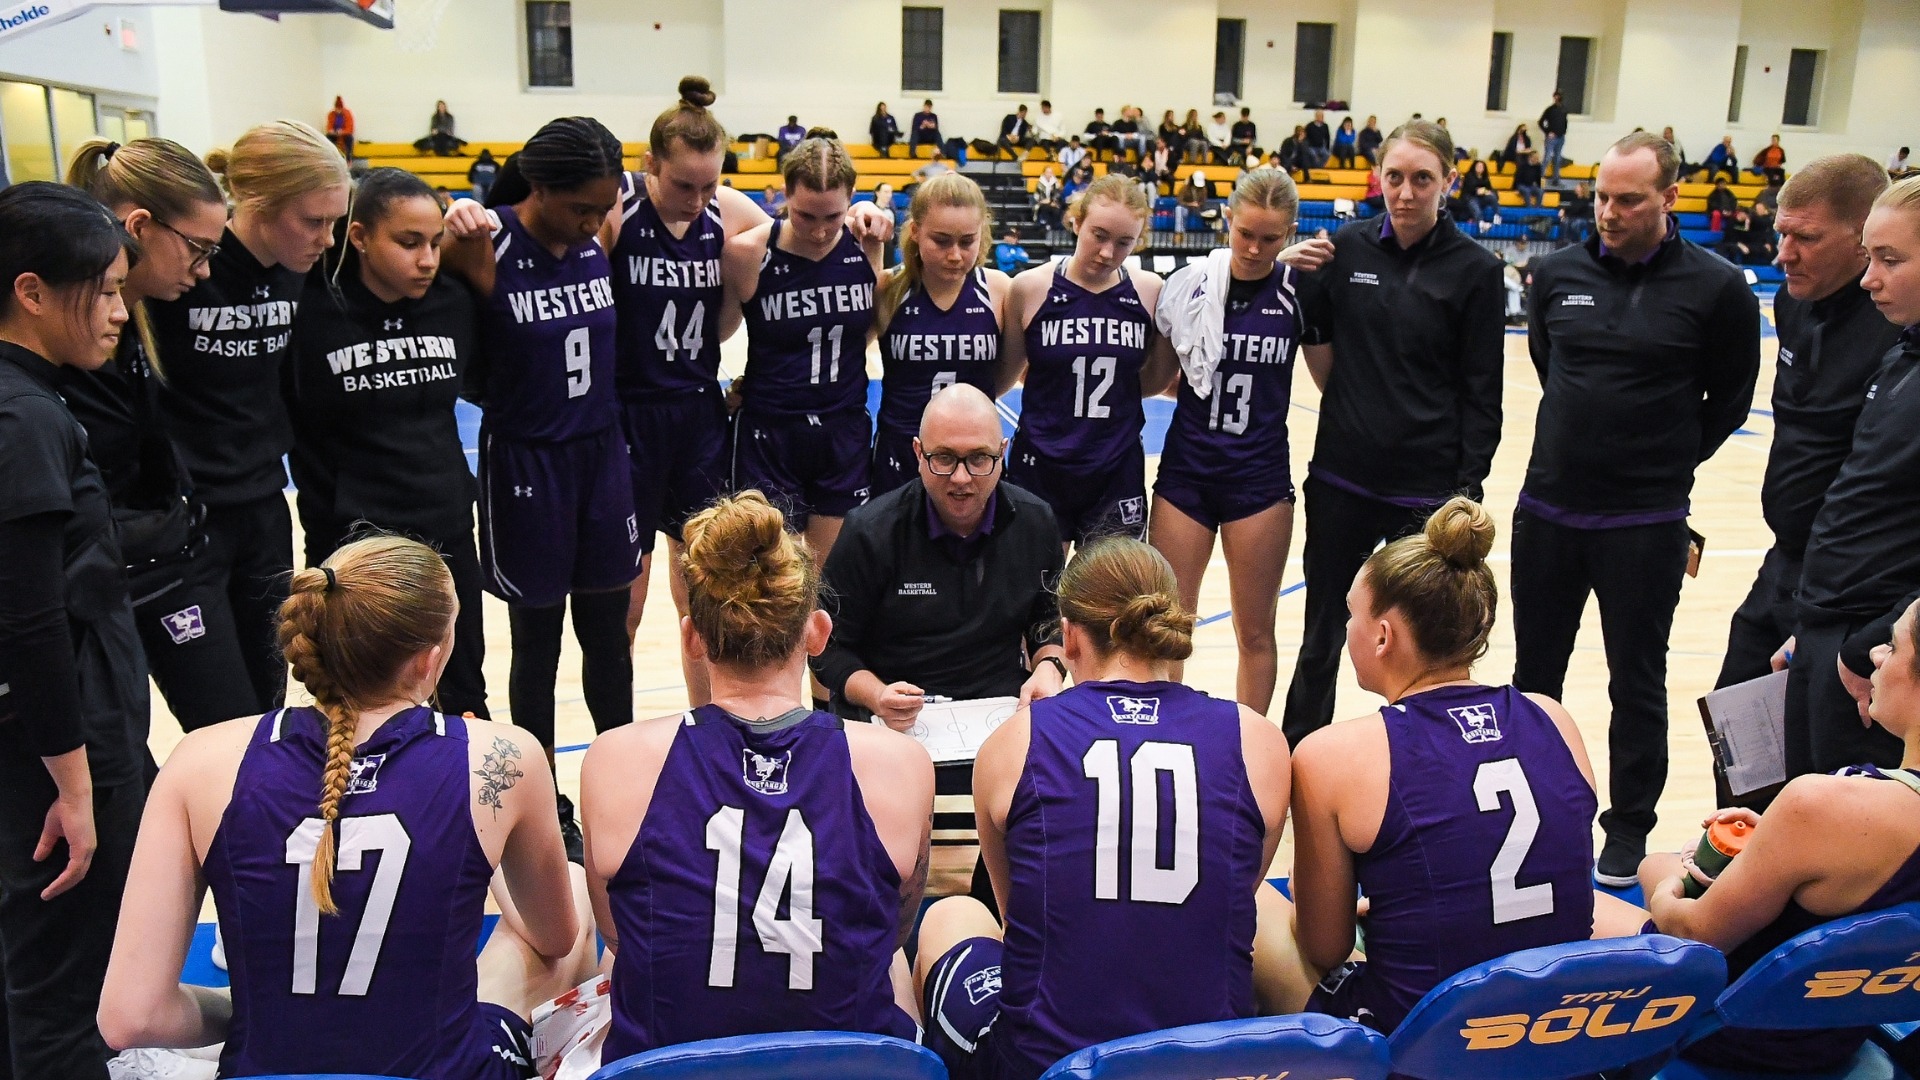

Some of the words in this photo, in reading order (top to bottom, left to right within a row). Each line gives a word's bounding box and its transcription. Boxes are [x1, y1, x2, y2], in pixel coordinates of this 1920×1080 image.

[0, 5, 50, 32] helde
[508, 276, 615, 323] WESTERN
[761, 282, 874, 321] WESTERN
[194, 329, 292, 357] BASKEBA
[326, 336, 457, 375] WESTERN
[655, 300, 706, 361] 44
[807, 324, 844, 384] 11
[890, 334, 997, 361] WESTERN
[1041, 317, 1146, 349] WESTERN
[1221, 333, 1290, 364] TERN
[343, 362, 457, 392] BASKETBALL
[564, 327, 592, 399] 9
[1071, 356, 1117, 418] 12
[1208, 371, 1253, 435] 13
[1083, 739, 1198, 904] 10
[1472, 758, 1553, 924] 2
[285, 813, 411, 996] 17
[705, 805, 823, 990] 14
[1803, 965, 1920, 998] BO
[1459, 995, 1696, 1050] BOLD
